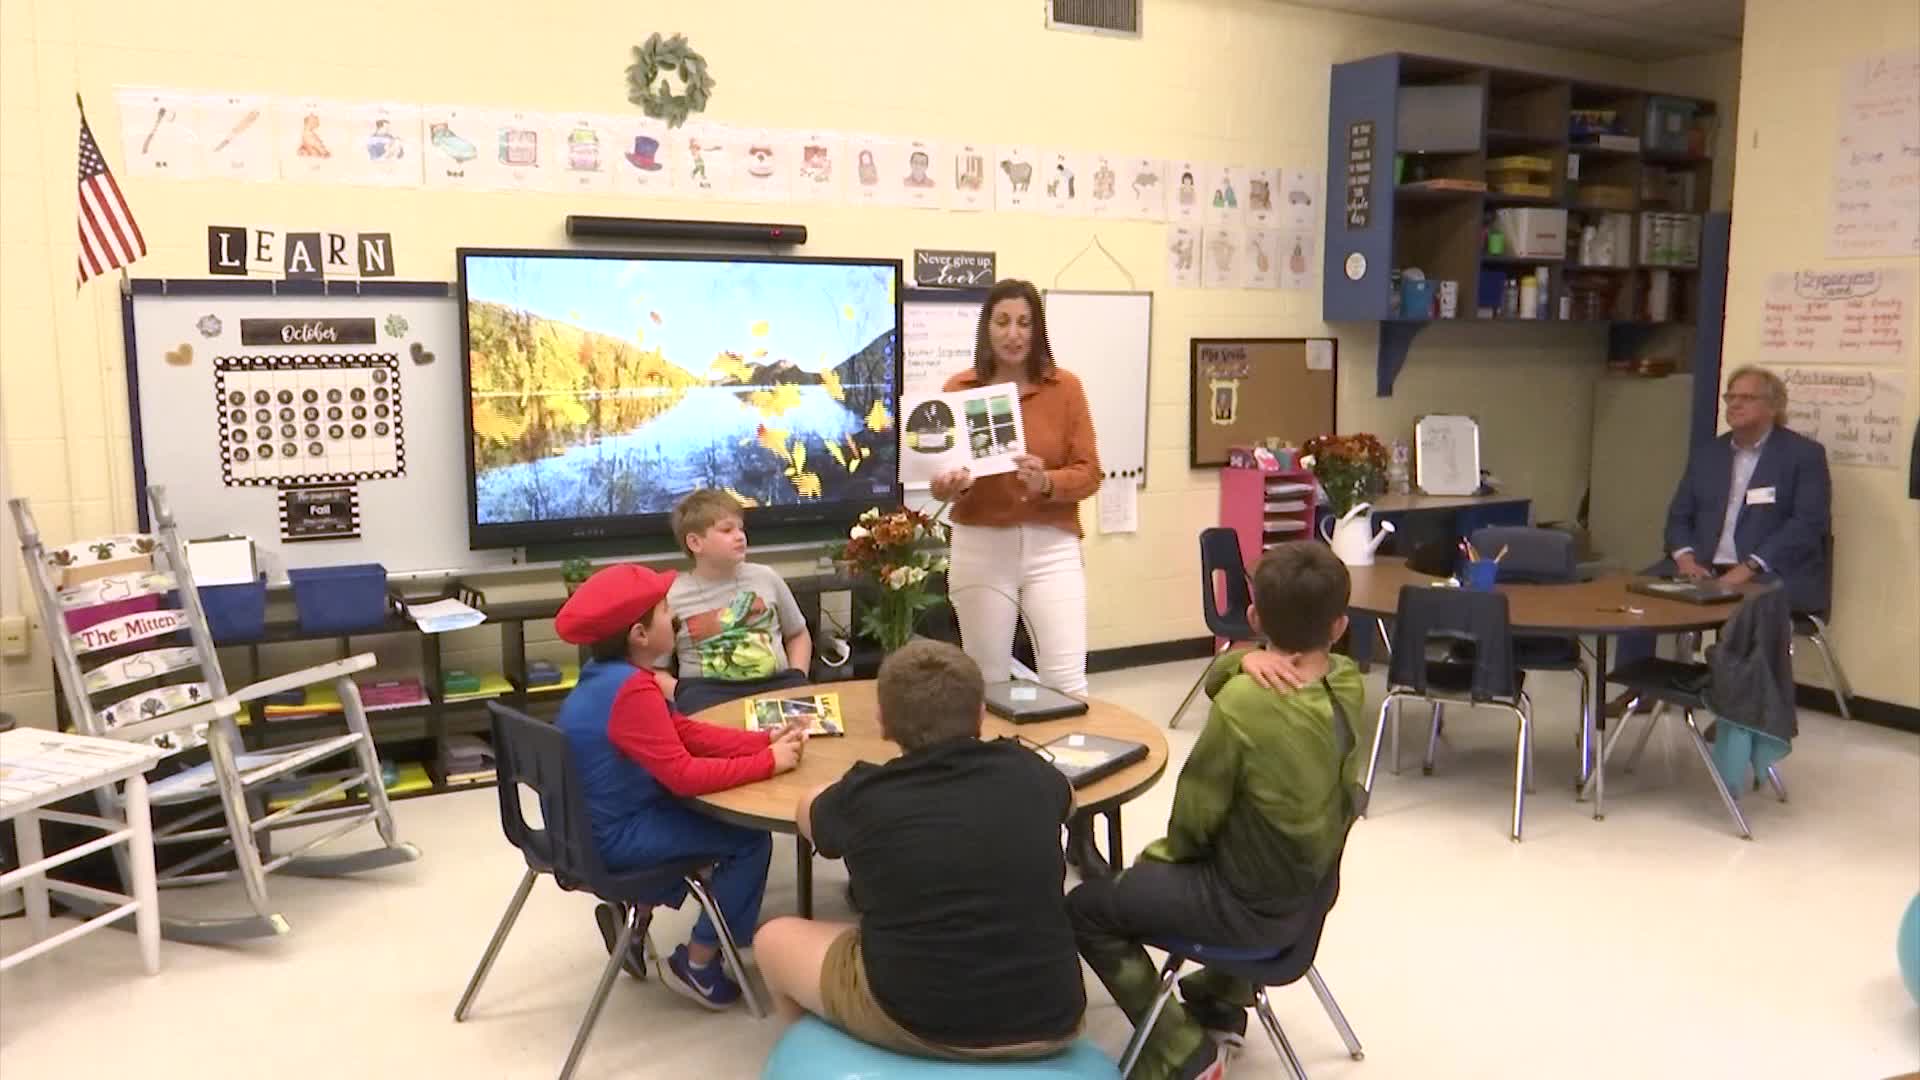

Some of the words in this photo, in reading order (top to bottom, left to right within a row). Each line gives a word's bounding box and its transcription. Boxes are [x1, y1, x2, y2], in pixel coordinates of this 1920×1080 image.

[218, 229, 386, 273] LEARN
[918, 252, 951, 265] Never
[953, 254, 976, 269] give
[280, 321, 339, 344] October
[309, 503, 332, 516] Fall
[81, 628, 119, 648] The
[124, 615, 177, 639] Mitten
